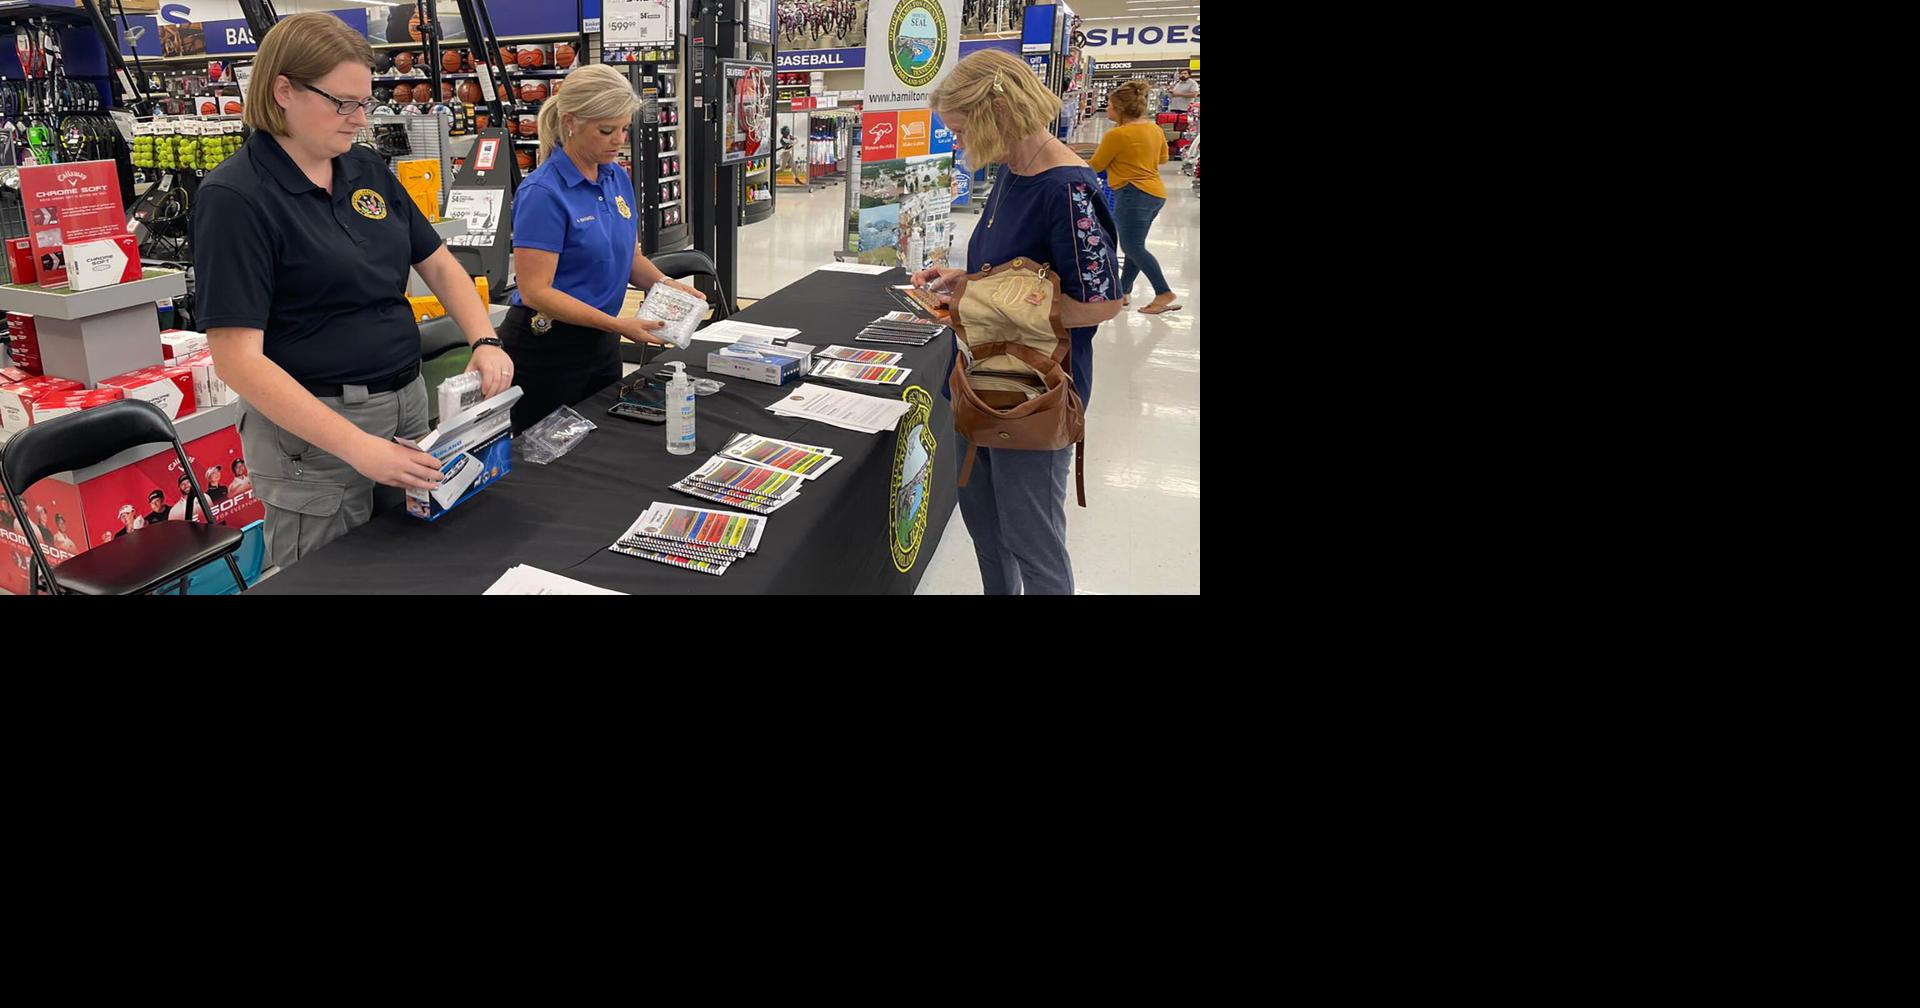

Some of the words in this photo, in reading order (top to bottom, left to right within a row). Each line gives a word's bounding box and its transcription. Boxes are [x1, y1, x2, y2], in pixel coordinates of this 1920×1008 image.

[911, 18, 927, 26] SEAL
[57, 171, 87, 182] Callaway
[36, 188, 78, 198] CHROME
[86, 254, 113, 263] CHROME
[210, 489, 253, 516] SOFT
